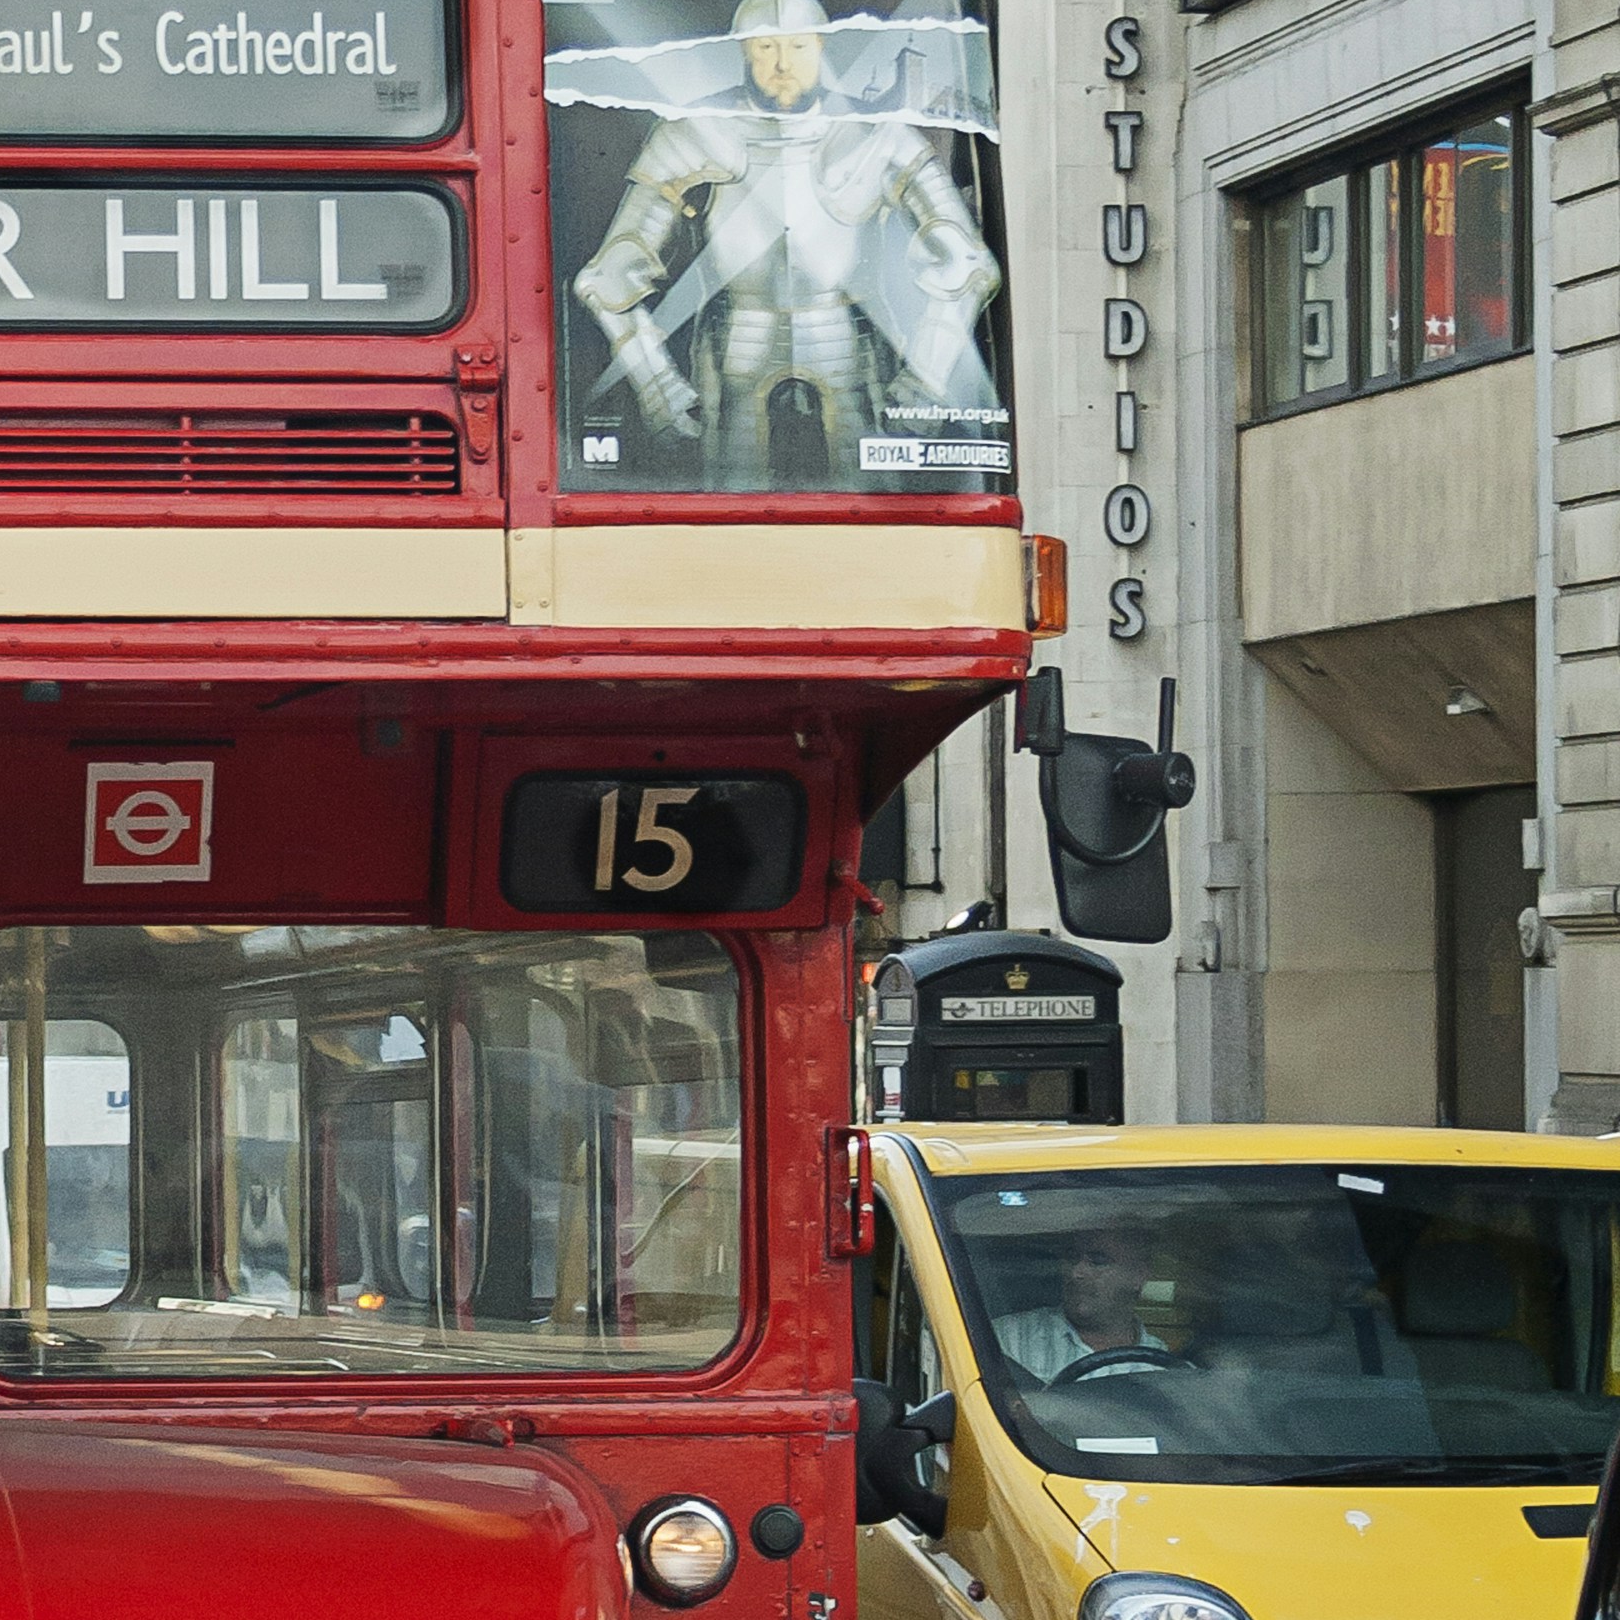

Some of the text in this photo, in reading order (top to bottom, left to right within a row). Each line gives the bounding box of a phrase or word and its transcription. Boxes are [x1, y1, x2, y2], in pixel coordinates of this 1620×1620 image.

[155, 10, 396, 75] Cathedral
[106, 200, 388, 300] HILL
[1102, 16, 1151, 642] STUDIOS
[866, 444, 1009, 467] ROYAL ARMOURIES
[592, 787, 701, 892] 15
[979, 998, 1094, 1017] TELEPHONE
